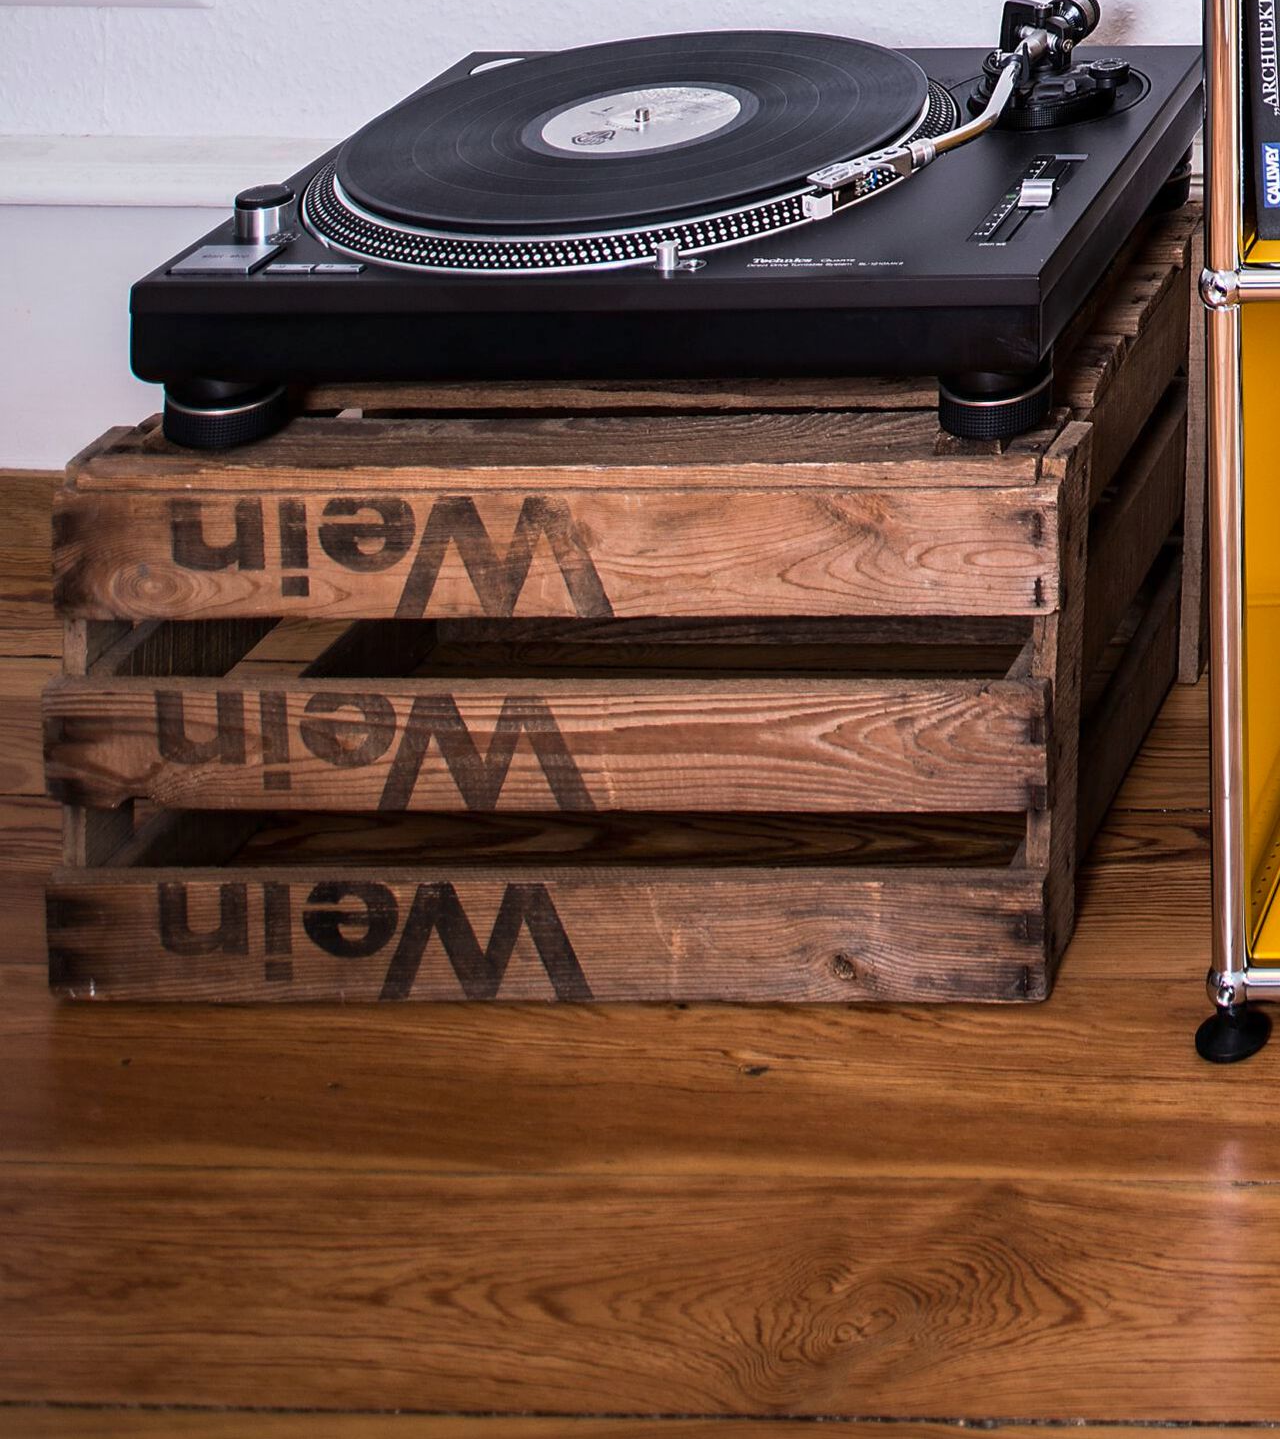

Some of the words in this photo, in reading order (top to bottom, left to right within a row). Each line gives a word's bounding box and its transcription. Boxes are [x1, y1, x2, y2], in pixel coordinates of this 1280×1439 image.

[171, 495, 614, 618] Wein
[154, 689, 596, 811] Wein
[158, 881, 594, 1002] Wein
